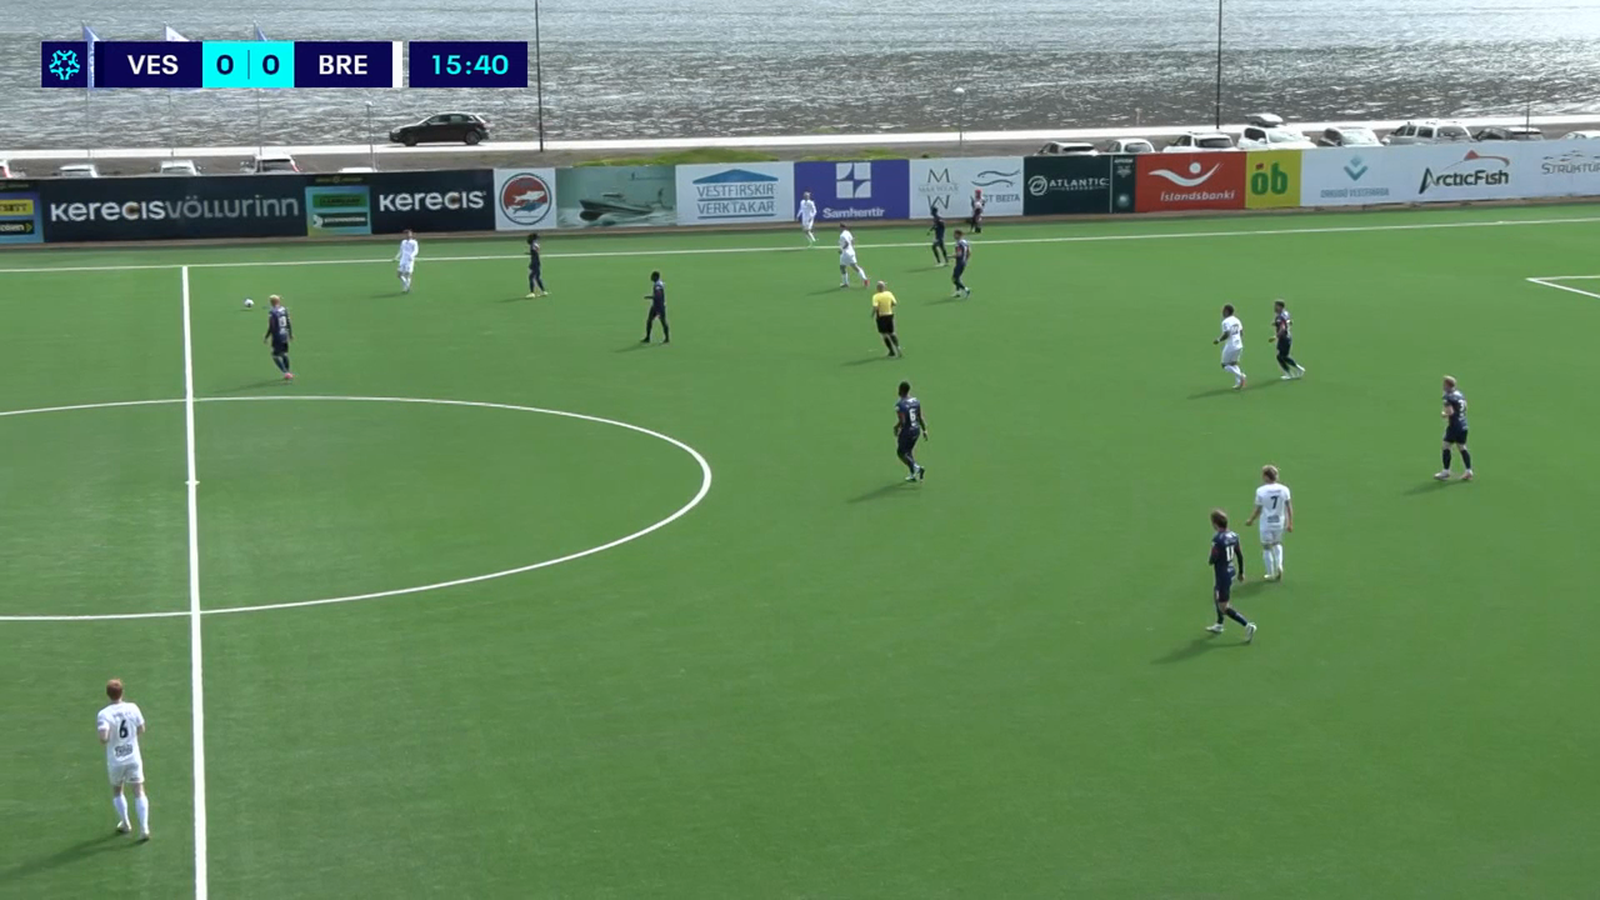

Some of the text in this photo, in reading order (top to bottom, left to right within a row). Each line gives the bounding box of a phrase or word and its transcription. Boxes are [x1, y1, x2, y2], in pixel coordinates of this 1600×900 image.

[1049, 177, 1110, 188] ATLANTIC
[1419, 167, 1510, 194] ArcticFish
[696, 183, 777, 198] VESTFIRSKIR
[697, 201, 777, 215] VERKTAKAR
[822, 207, 886, 219] Samhentir
[1270, 495, 1280, 509] 7
[119, 719, 129, 739] 6
